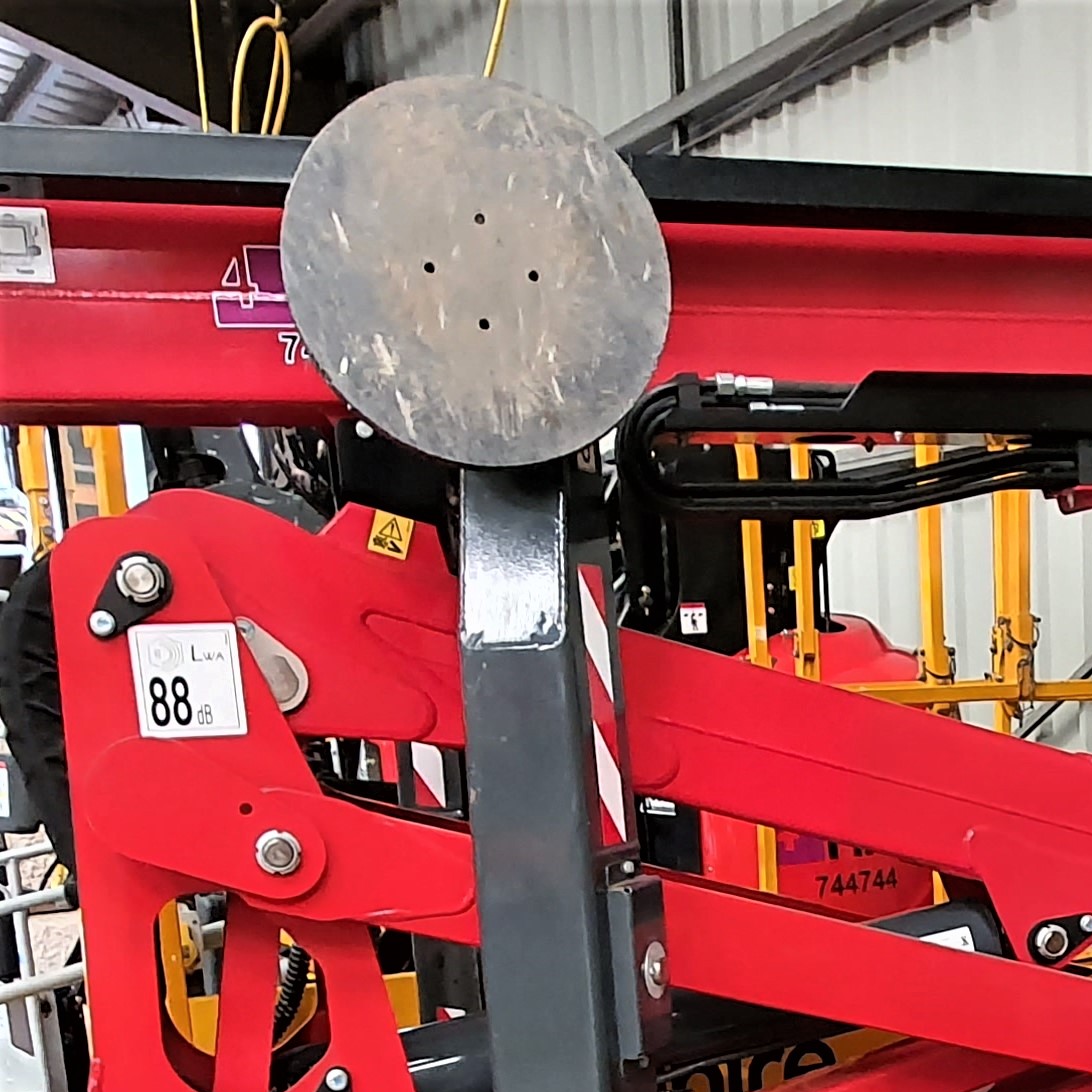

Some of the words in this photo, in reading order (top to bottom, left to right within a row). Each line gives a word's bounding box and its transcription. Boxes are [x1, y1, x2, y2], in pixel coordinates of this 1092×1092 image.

[278, 331, 311, 365] 7
[149, 675, 193, 727] 88
[197, 703, 214, 725] dB
[815, 867, 898, 899] 744744
